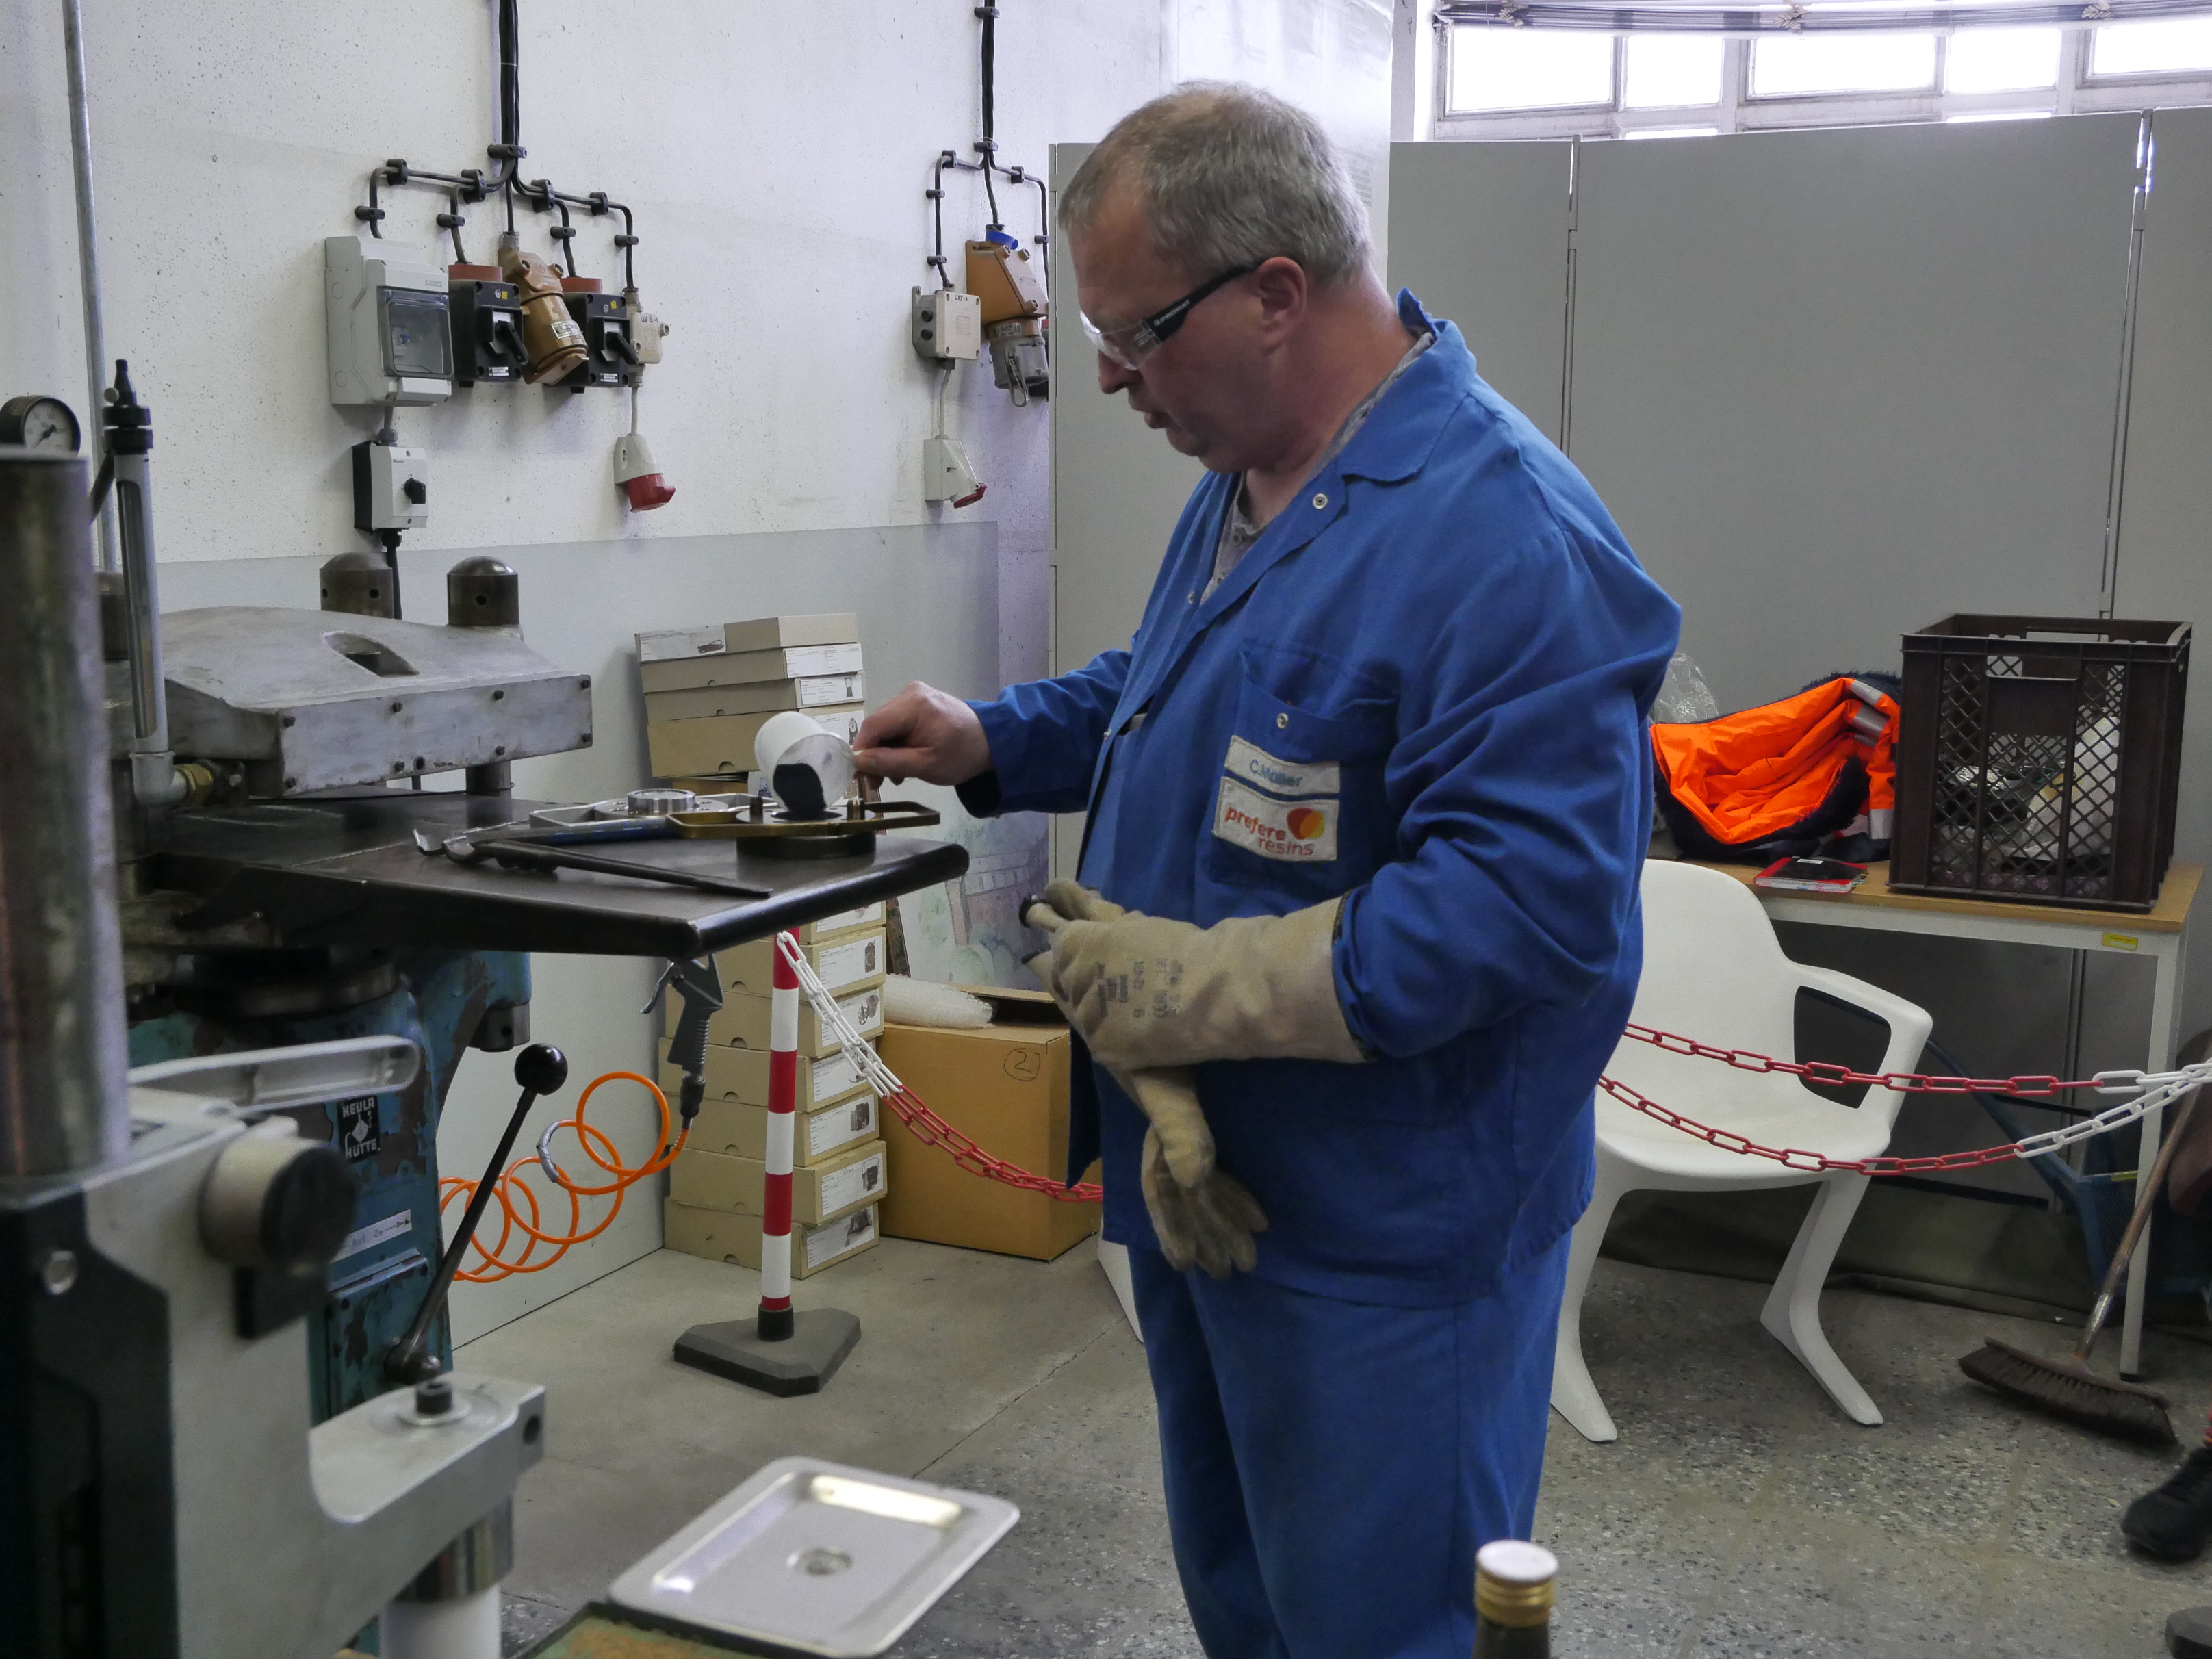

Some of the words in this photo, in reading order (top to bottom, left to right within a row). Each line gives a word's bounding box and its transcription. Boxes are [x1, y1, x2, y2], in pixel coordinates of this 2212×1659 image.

[1225, 806, 1287, 841] prefere
[1259, 837, 1314, 856] resins
[1014, 1050, 1032, 1073] 2
[342, 1096, 374, 1118] KEULA
